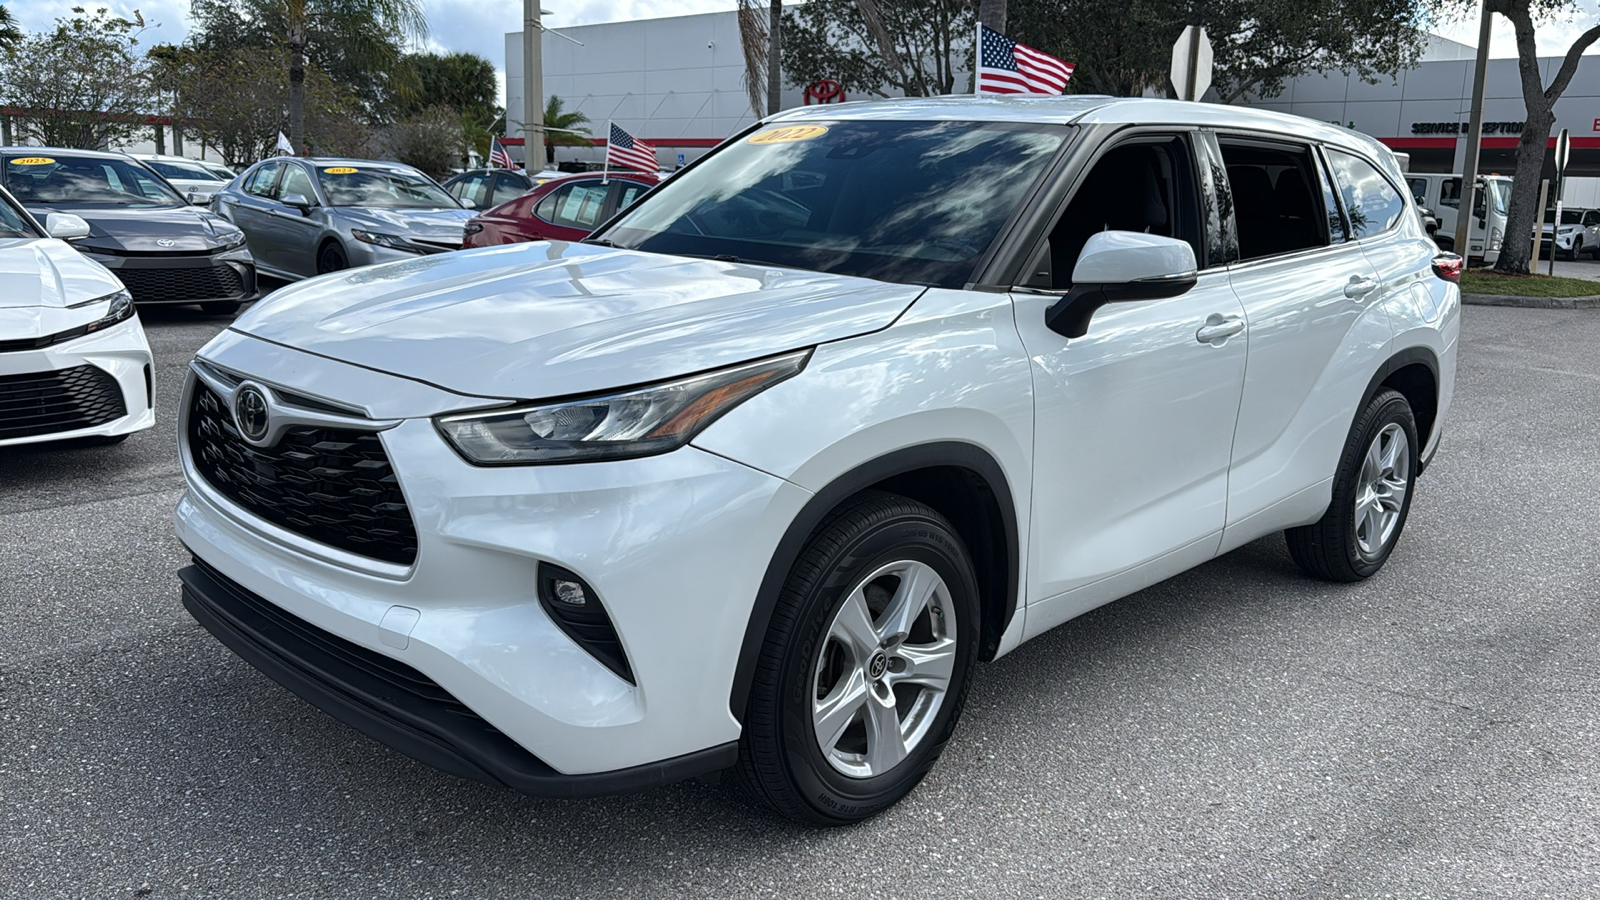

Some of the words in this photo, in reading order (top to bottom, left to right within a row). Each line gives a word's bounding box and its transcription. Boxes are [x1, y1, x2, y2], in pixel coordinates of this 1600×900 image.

[754, 127, 818, 142] 2022
[1411, 122, 1460, 134] SERVICE
[1461, 121, 1525, 134] REPTION
